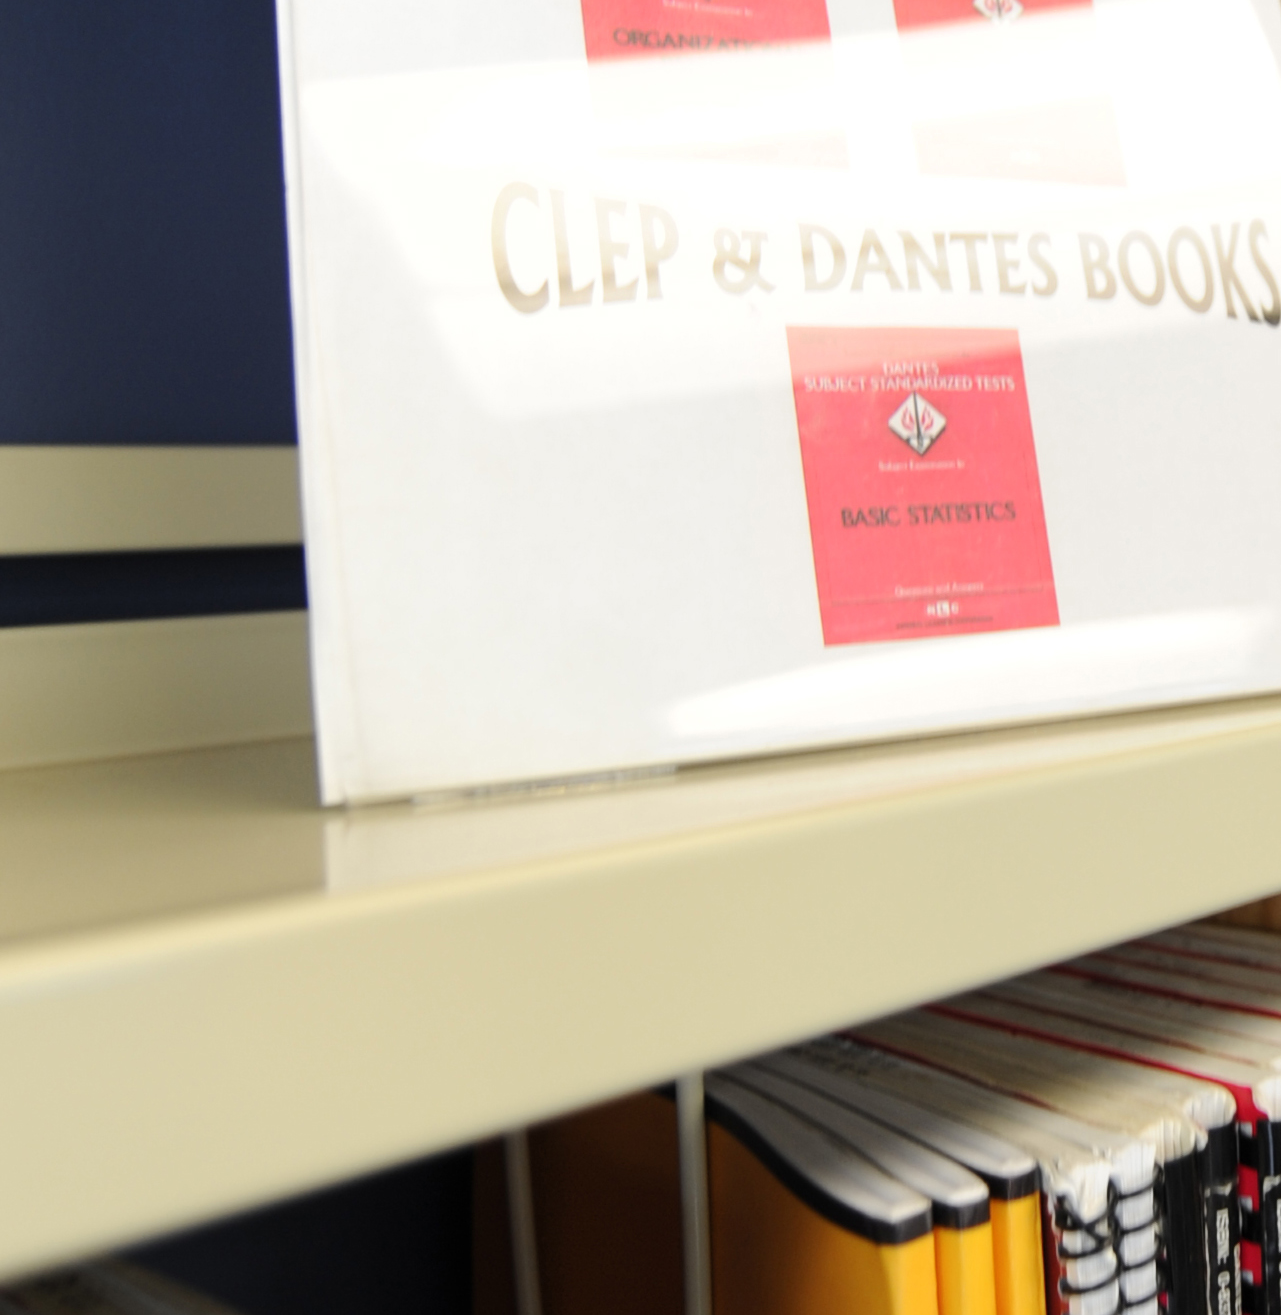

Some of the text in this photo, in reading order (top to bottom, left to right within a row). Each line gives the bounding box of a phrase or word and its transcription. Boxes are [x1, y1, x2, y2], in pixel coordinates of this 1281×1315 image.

[490, 179, 680, 314] CLEP
[712, 227, 776, 297] &
[799, 223, 1060, 298] DANTES
[883, 360, 940, 375] DANTES
[804, 375, 1016, 393] SUBJECT STANDARDIZED TESTS
[840, 501, 1016, 529] BASIC STATISTICS
